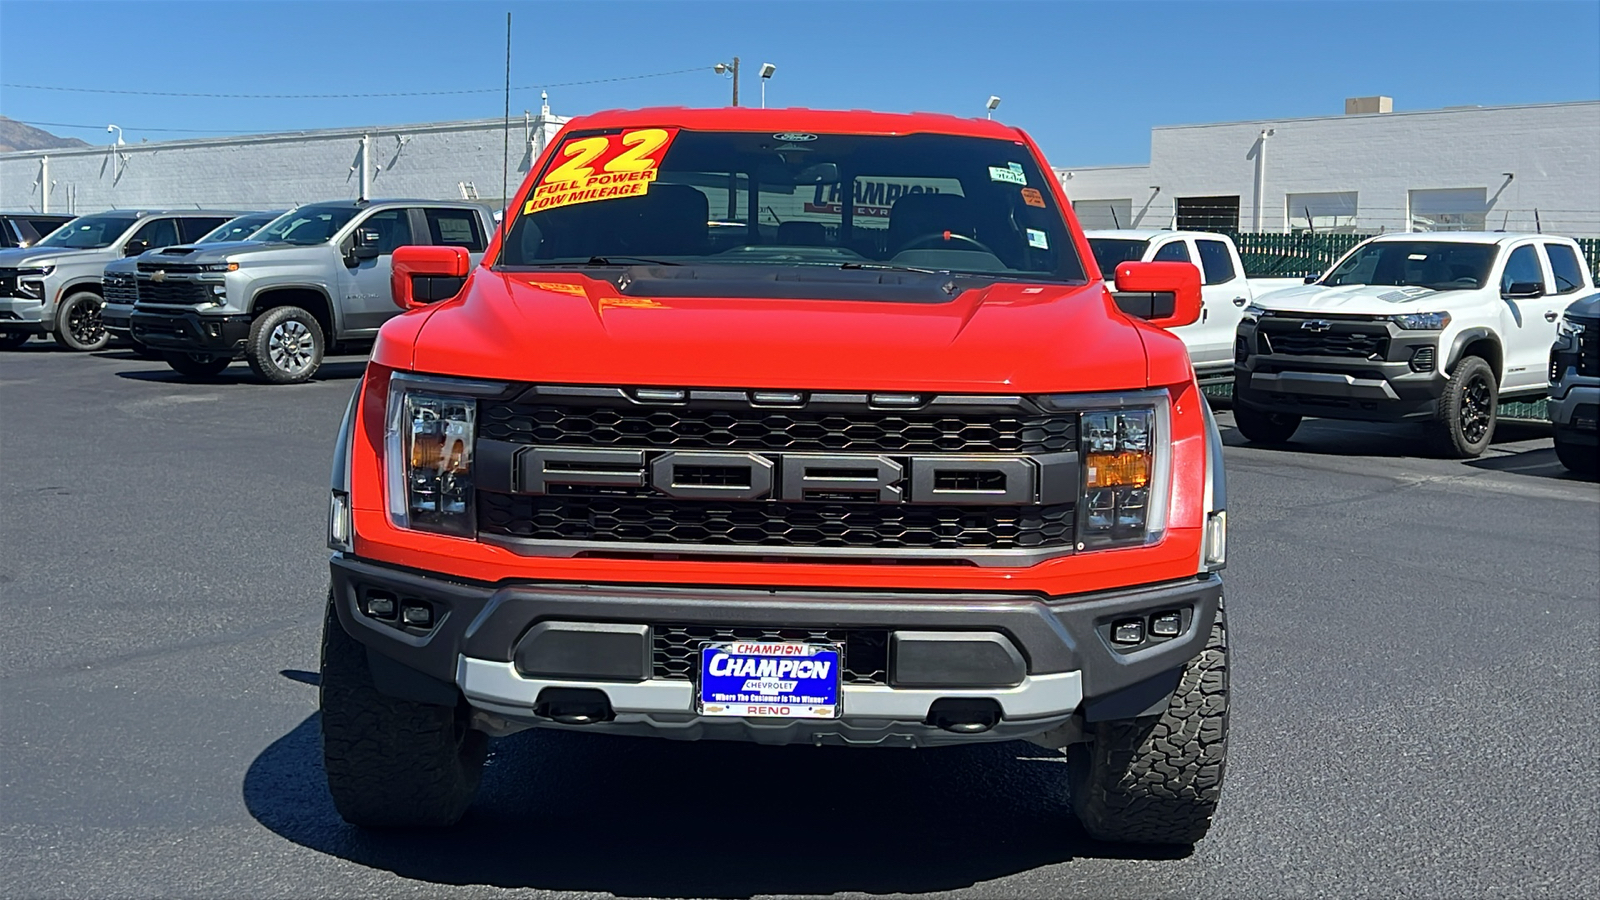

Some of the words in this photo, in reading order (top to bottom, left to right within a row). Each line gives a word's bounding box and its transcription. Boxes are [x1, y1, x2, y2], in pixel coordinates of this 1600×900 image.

[544, 128, 669, 183] 22
[530, 194, 568, 210] LOW
[568, 182, 642, 202] MILEAGE
[536, 180, 581, 197] FULL
[586, 170, 653, 187] POWER
[518, 447, 1036, 504] FORD
[737, 645, 803, 654] CHAMPION
[708, 653, 831, 679] CHAMPION
[737, 694, 750, 702] The
[751, 694, 780, 703] Customer
[789, 695, 801, 703] The
[746, 681, 793, 690] CHEVROLET
[747, 706, 791, 716] RENO
